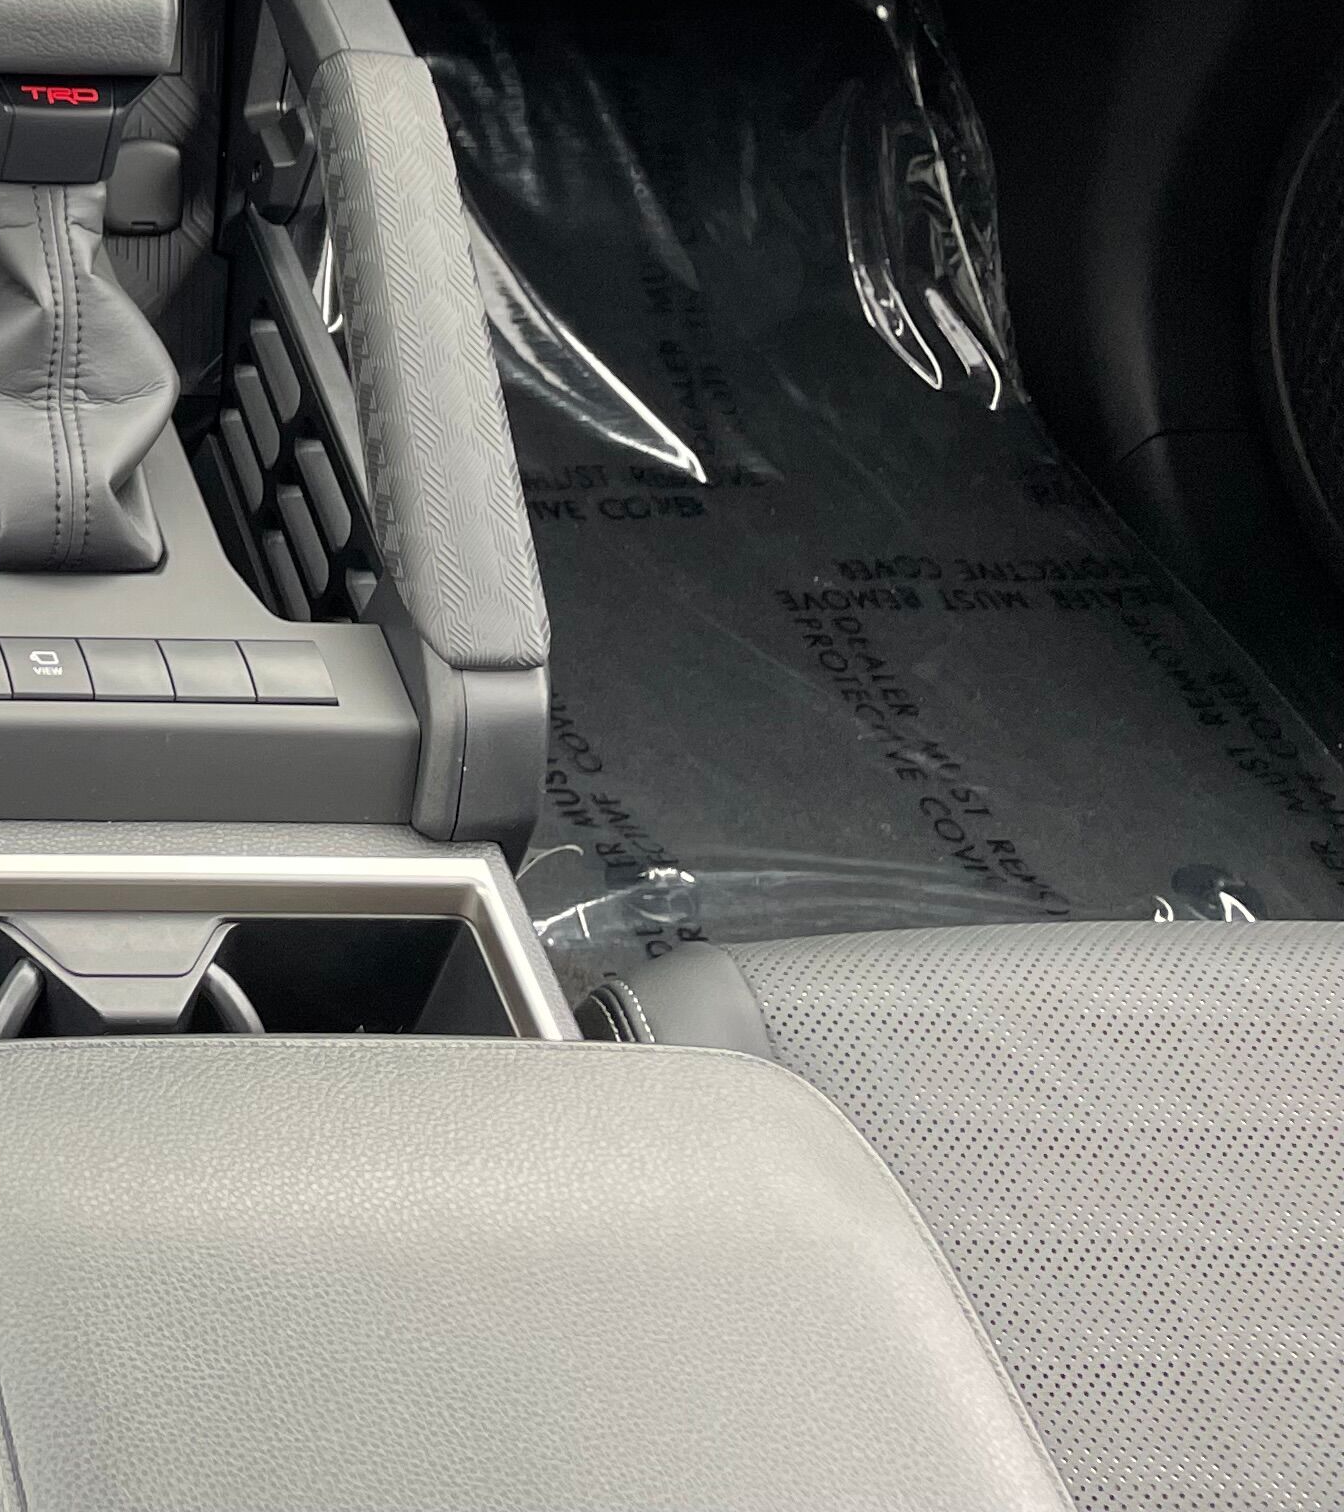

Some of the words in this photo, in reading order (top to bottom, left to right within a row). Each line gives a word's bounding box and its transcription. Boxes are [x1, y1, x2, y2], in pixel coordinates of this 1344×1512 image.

[21, 85, 99, 105] TRD
[773, 588, 925, 612] REMOVE
[32, 666, 63, 676] VIEW
